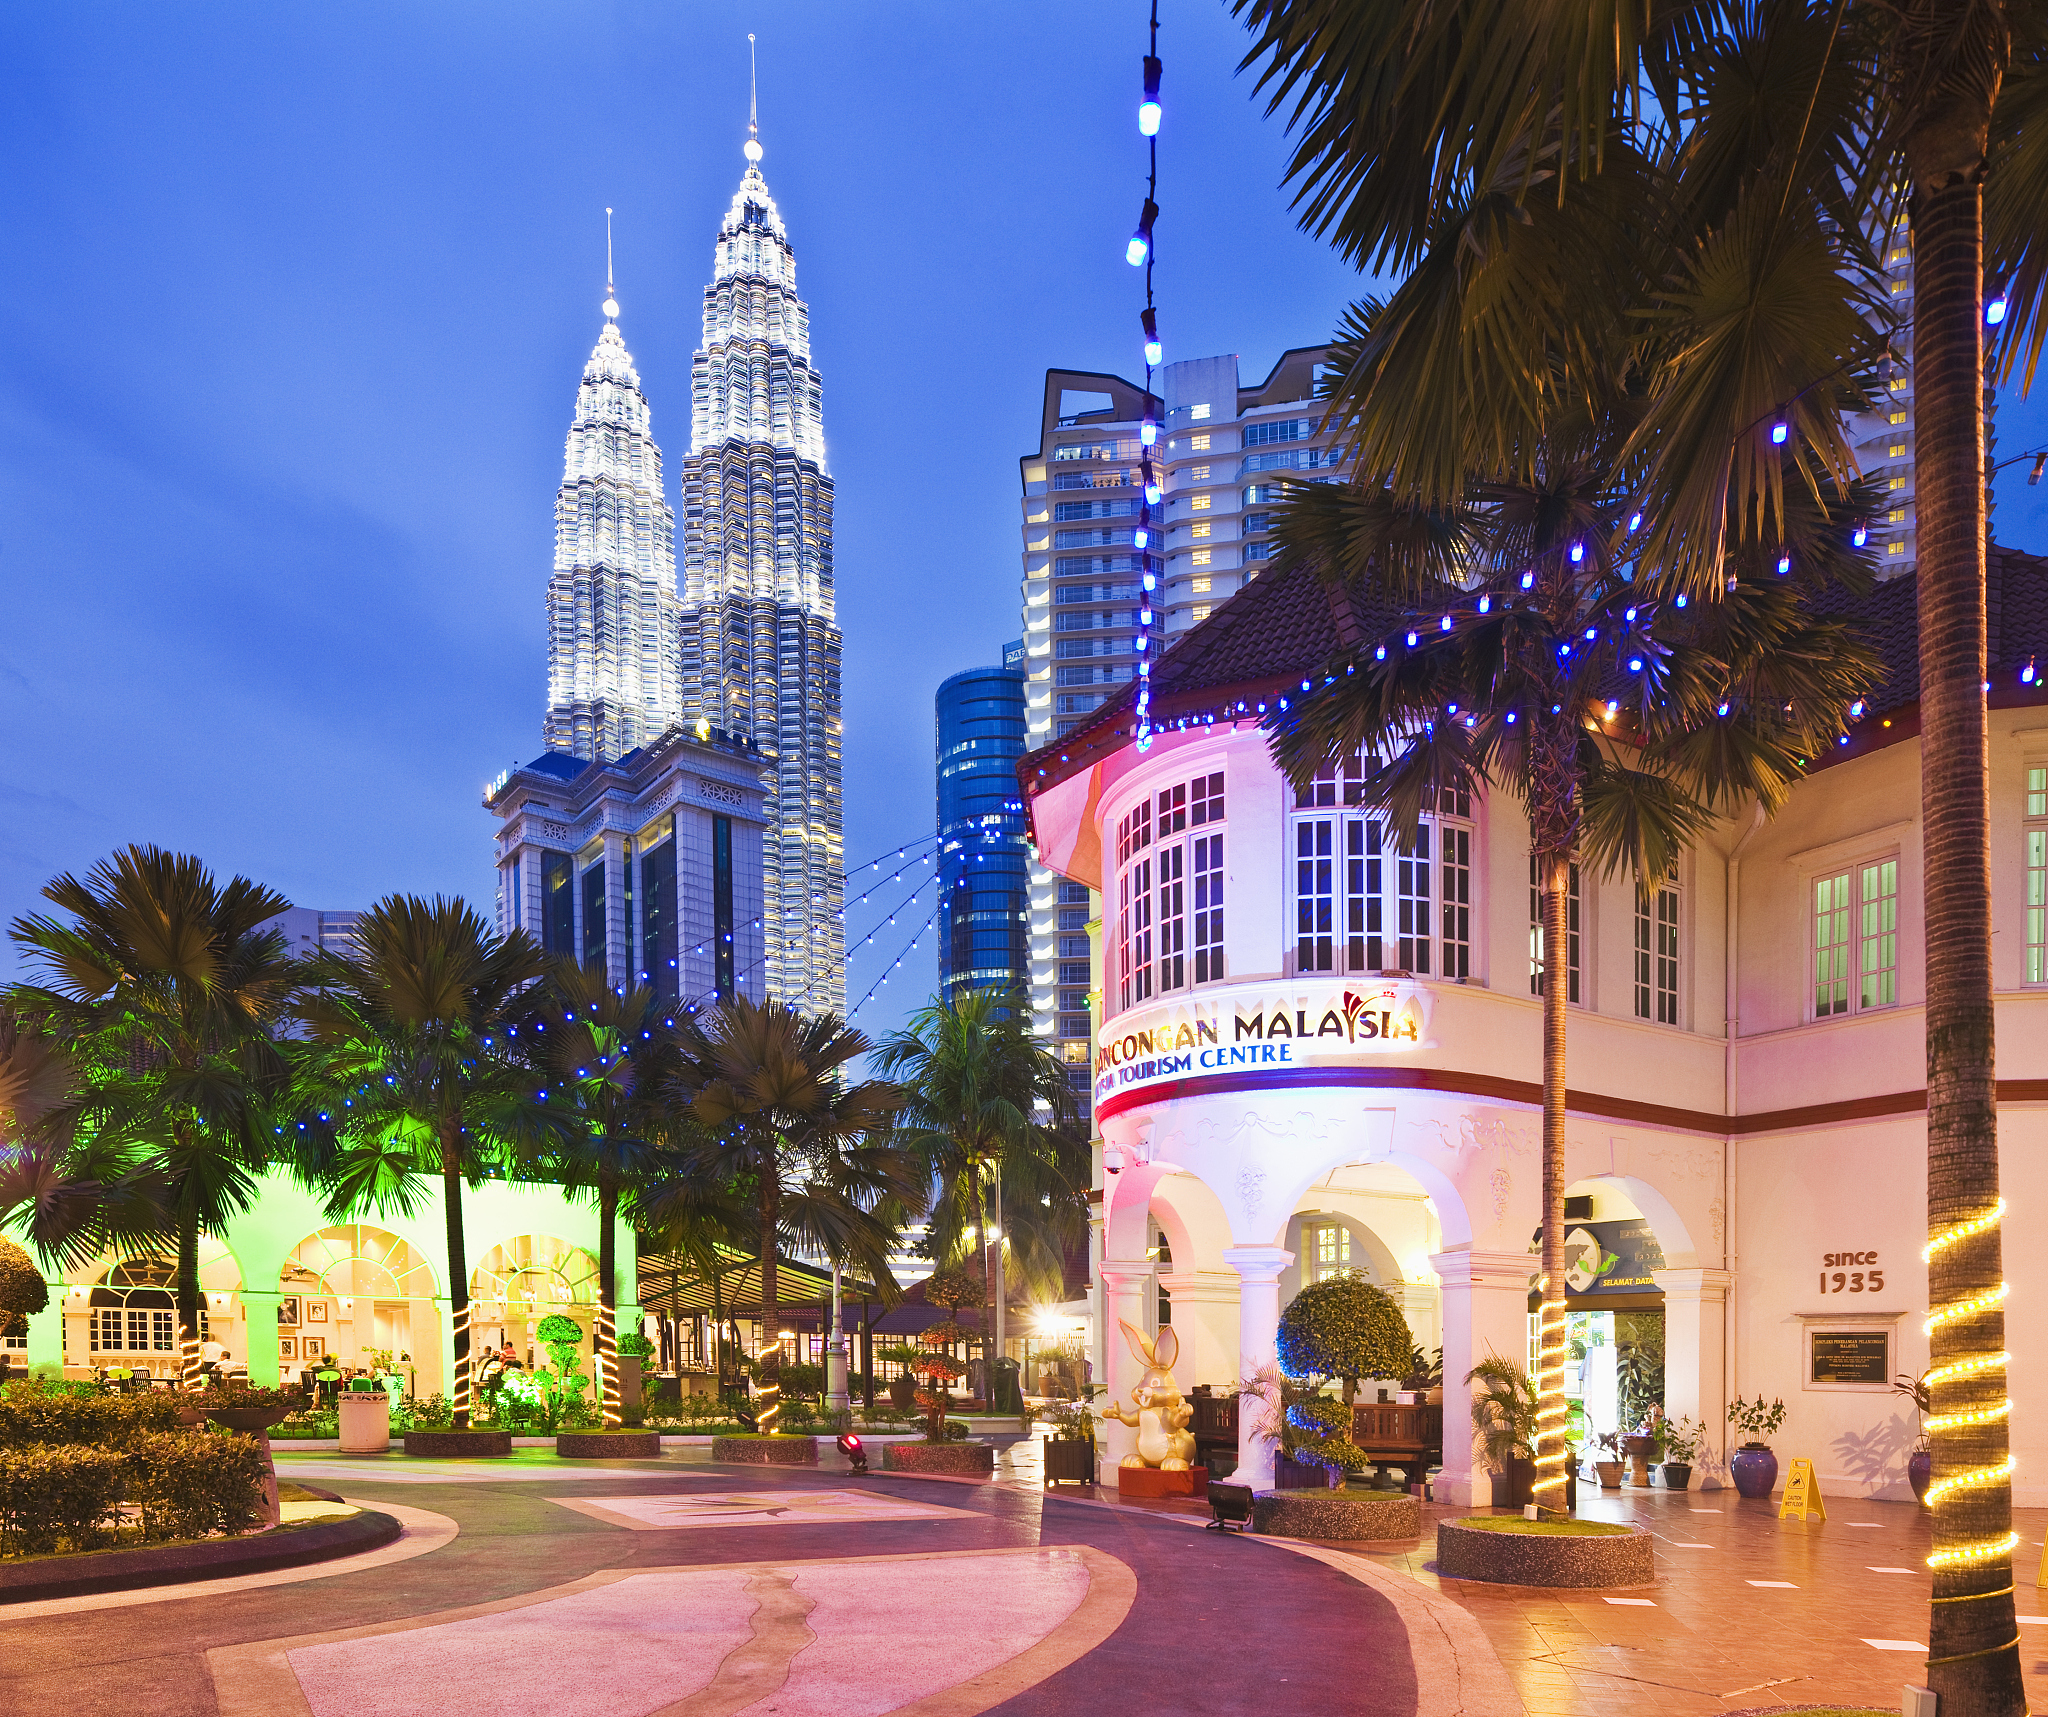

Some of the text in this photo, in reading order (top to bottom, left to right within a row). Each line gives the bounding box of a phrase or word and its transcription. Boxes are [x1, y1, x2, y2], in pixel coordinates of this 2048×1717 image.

[1234, 1005, 1418, 1044] MALAYSIA
[1118, 1053, 1192, 1085] TOURISM
[1199, 1043, 1293, 1068] CENTRE
[1602, 1277, 1656, 1287] SELAMAT DATA
[1820, 1271, 1885, 1294] 1935
